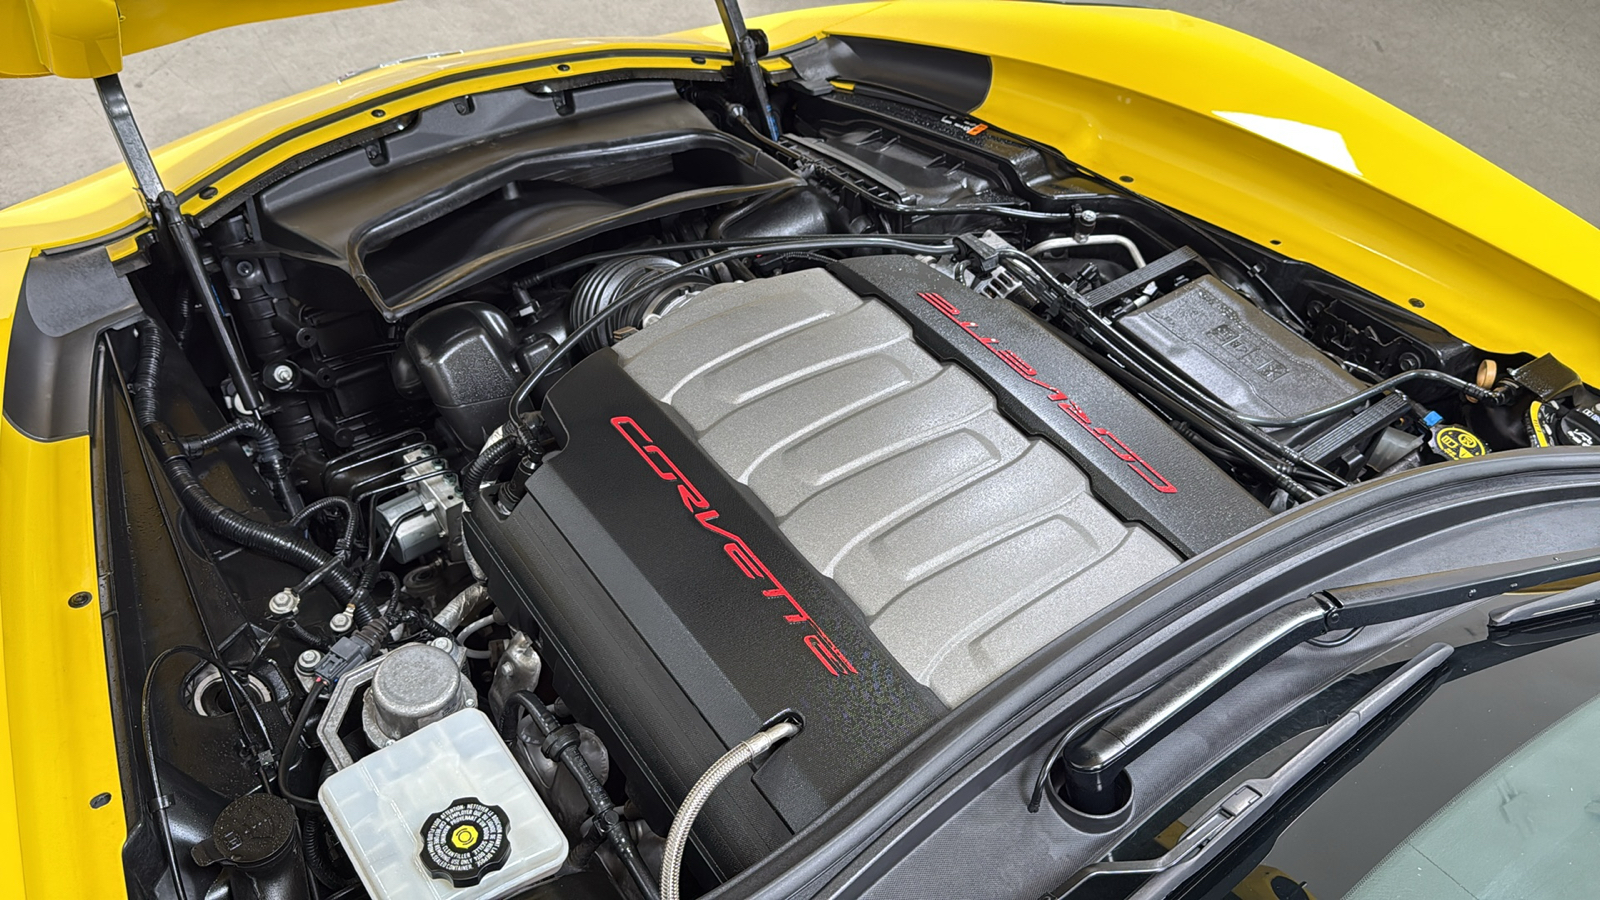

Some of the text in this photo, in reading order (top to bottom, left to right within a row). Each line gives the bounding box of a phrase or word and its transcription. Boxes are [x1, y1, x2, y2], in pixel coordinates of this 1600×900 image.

[920, 292, 1177, 493] CORVETTE
[610, 416, 858, 676] CORVETTE
[460, 857, 473, 866] ONLY
